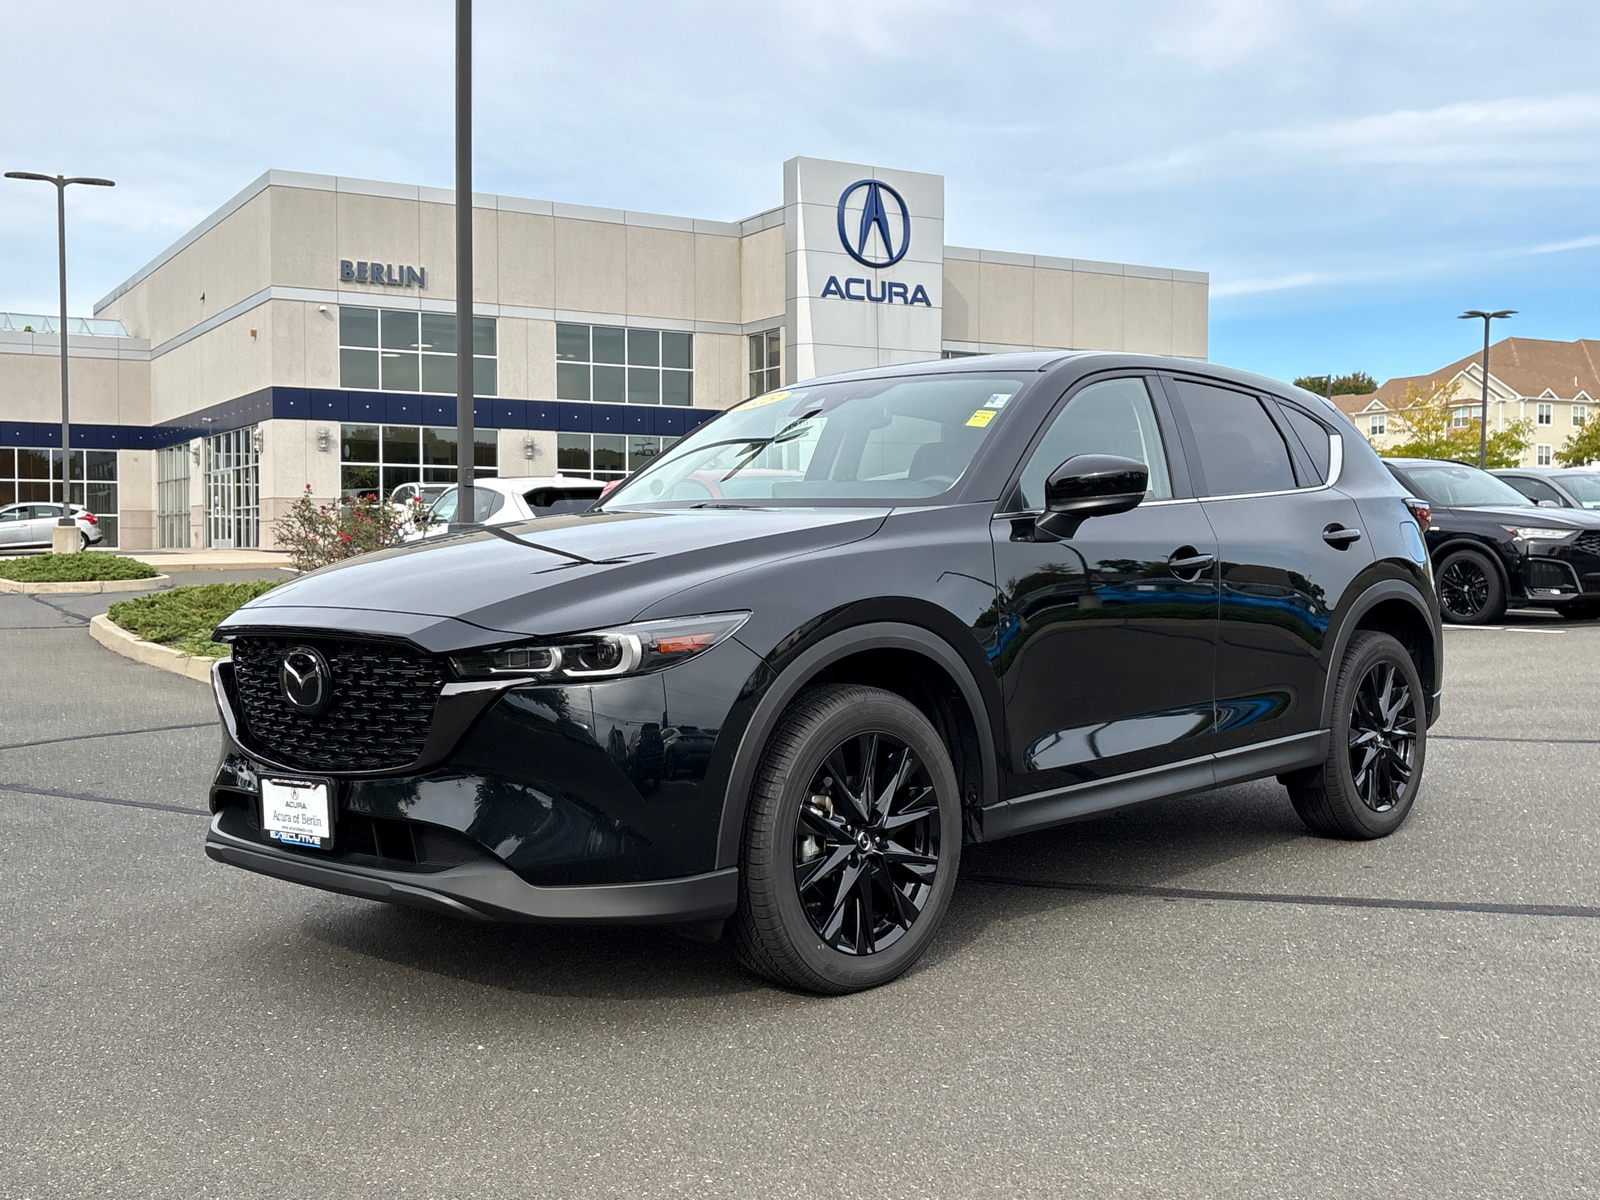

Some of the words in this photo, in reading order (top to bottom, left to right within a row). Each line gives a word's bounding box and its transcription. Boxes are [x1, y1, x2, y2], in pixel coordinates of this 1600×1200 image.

[340, 259, 425, 288] BERLIN
[821, 275, 932, 307] ACURA
[285, 800, 307, 810] ACURA
[272, 810, 292, 823] Acura
[292, 813, 300, 824] of
[301, 813, 322, 827] Berlin
[270, 830, 321, 845] EXECUTIVE
